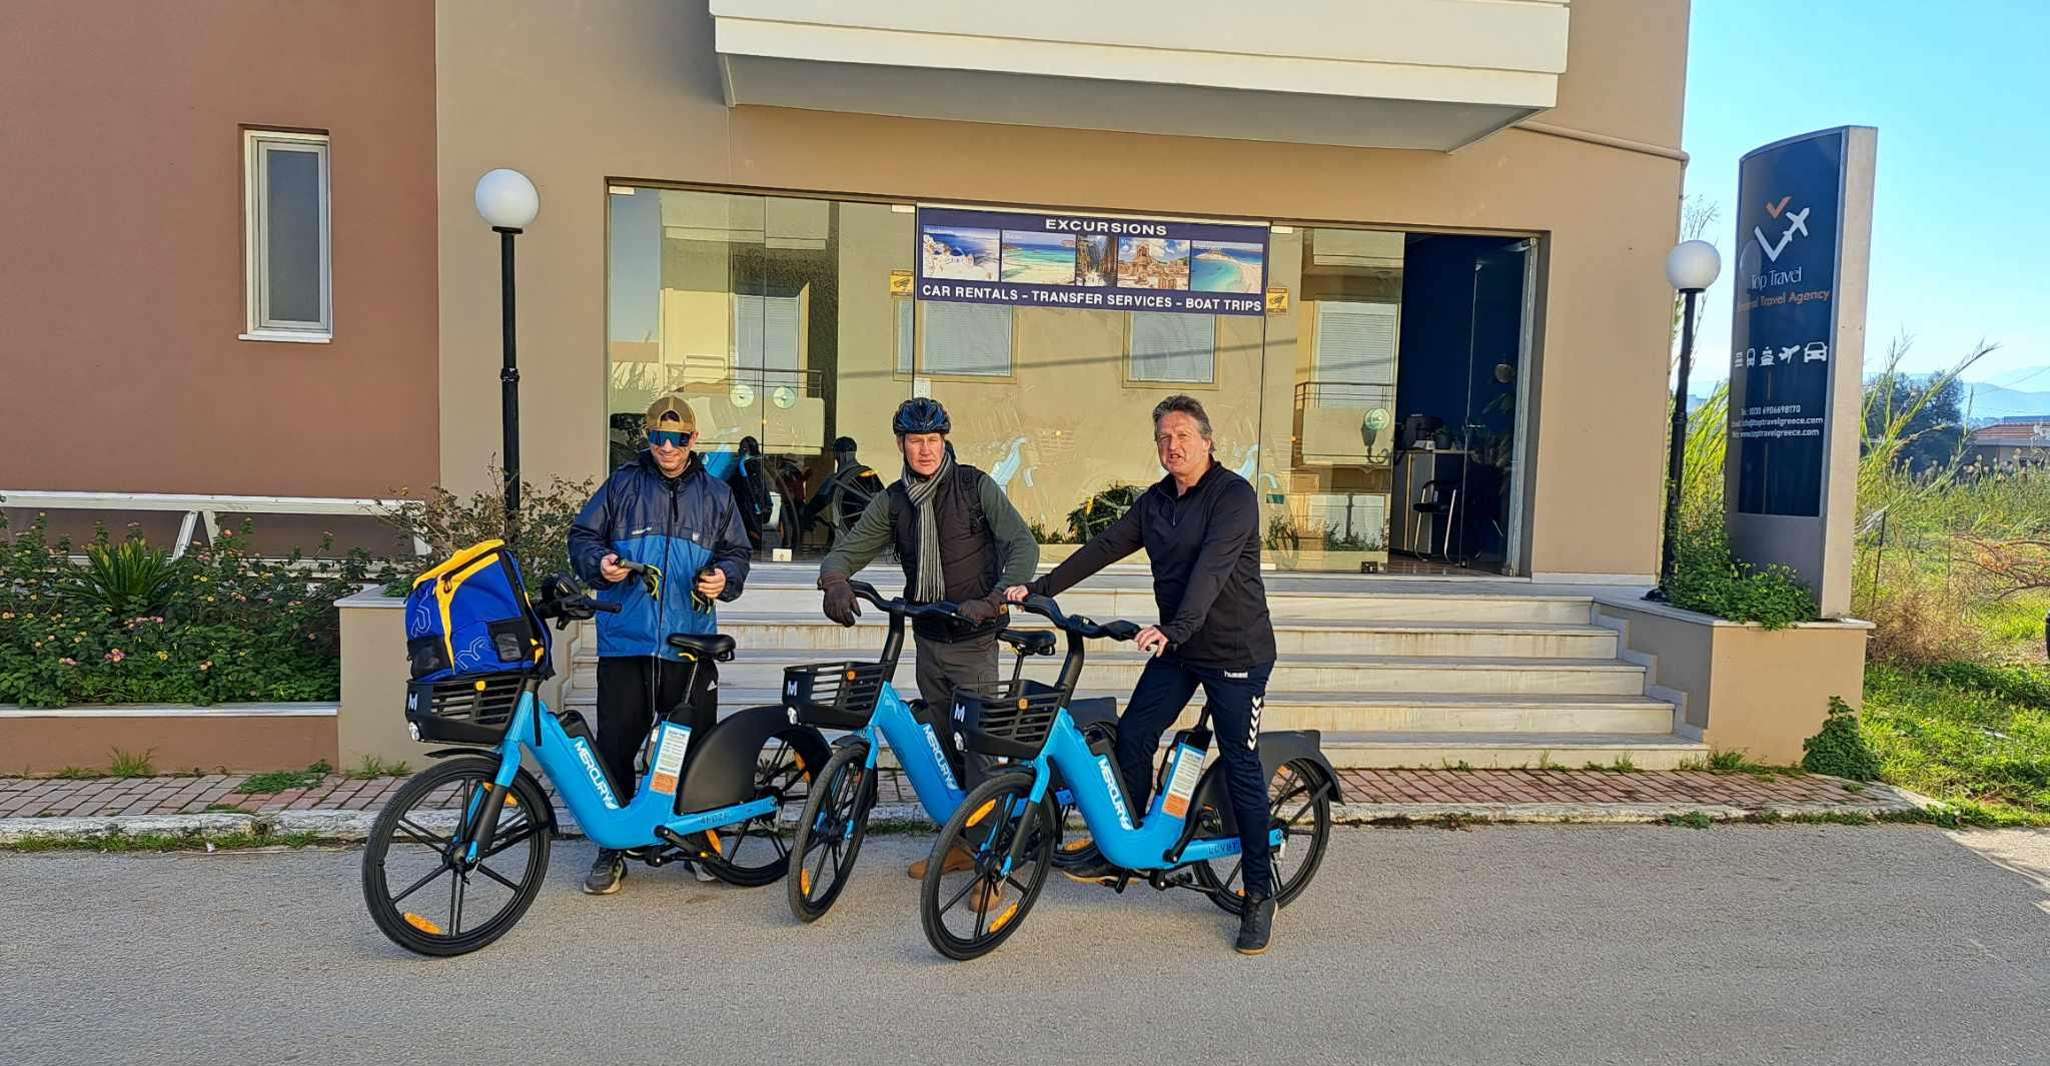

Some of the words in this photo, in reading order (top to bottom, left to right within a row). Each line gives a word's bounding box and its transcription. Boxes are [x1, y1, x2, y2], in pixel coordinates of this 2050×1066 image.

[1045, 218, 1168, 236] EXCURSIONS
[1769, 265, 1802, 286] Travel
[922, 284, 951, 298] CAR
[955, 286, 1018, 301] RENTALS
[1031, 290, 1102, 305] TRANSFER
[1107, 293, 1172, 308] SERVICES
[1185, 298, 1220, 310] BOAT
[1223, 300, 1262, 312] TRIPS
[1788, 289, 1830, 304] Agency
[787, 680, 798, 697] M
[408, 692, 418, 711] M
[953, 703, 966, 723] M
[923, 724, 960, 787] MERCURY
[574, 740, 616, 806] MERCURY
[1099, 757, 1133, 826] MERCURY
